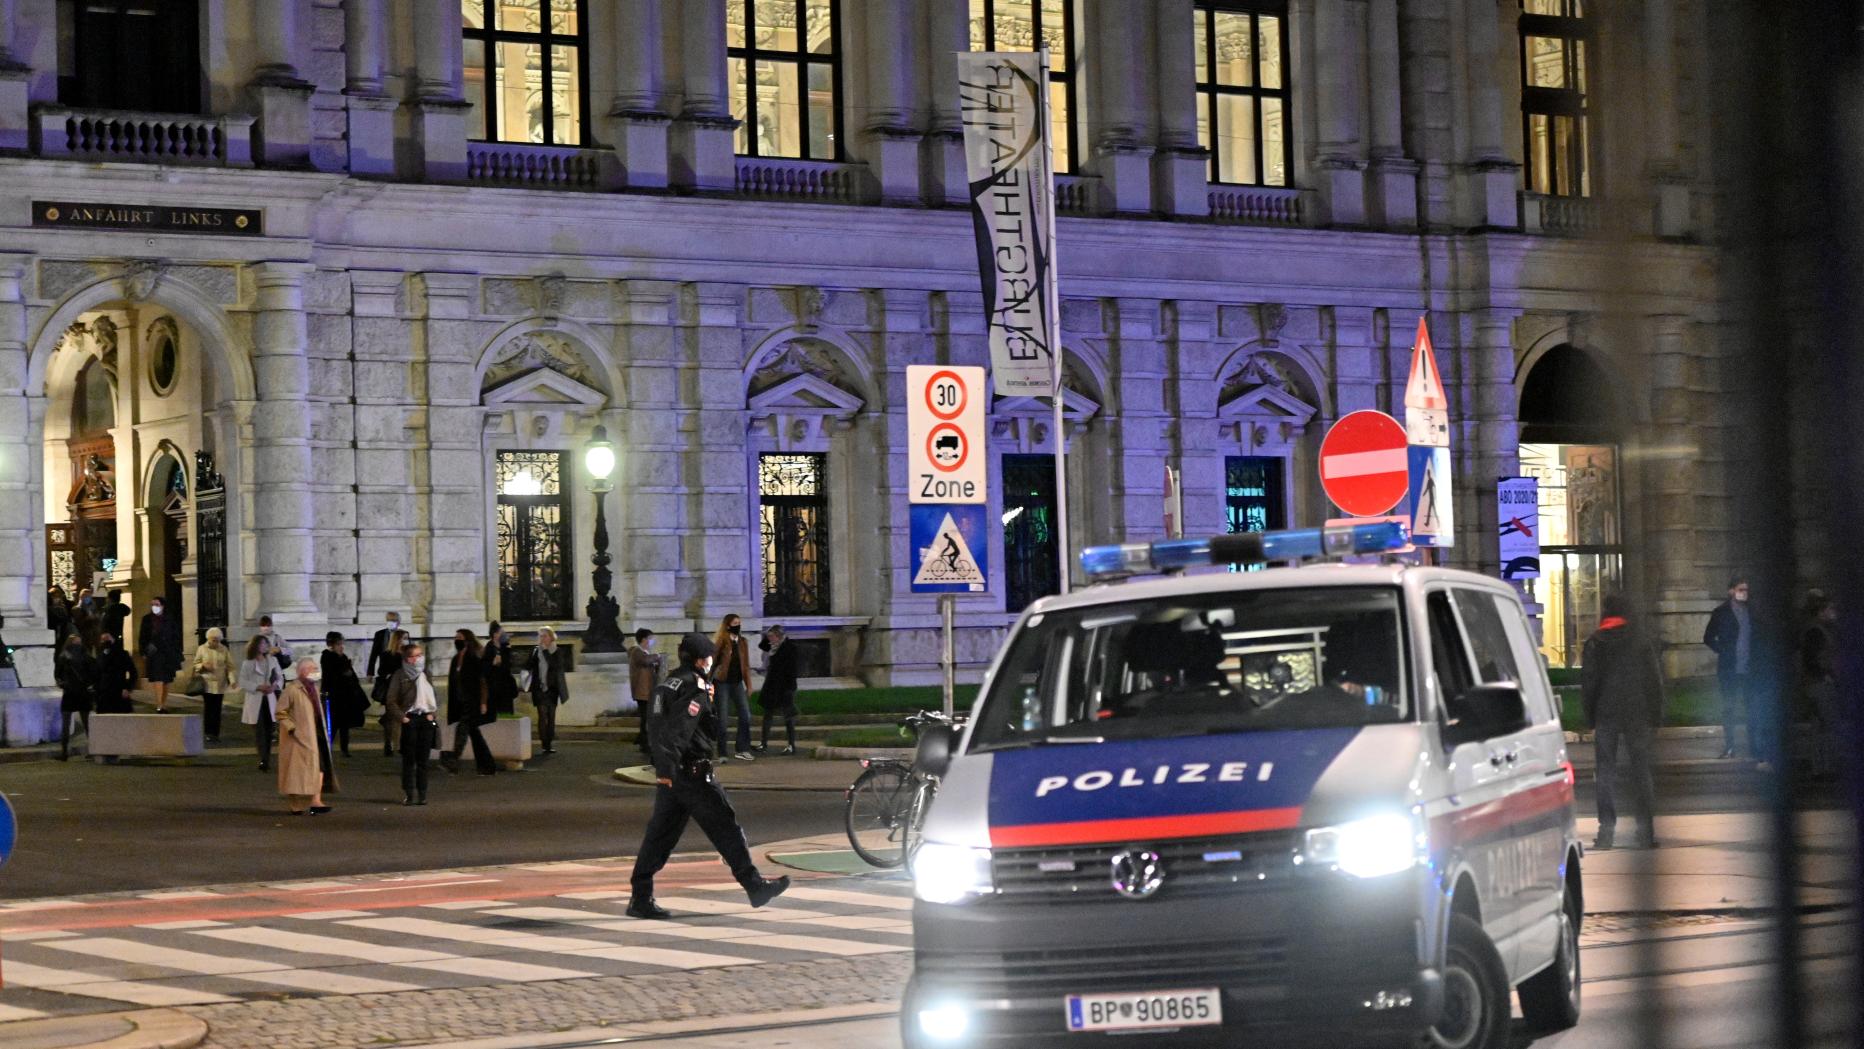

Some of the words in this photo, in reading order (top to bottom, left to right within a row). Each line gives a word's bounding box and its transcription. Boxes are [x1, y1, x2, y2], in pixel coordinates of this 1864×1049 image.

[69, 207, 154, 223] ANFAHRT
[171, 211, 223, 227] LINKS
[937, 384, 956, 406] 30
[920, 473, 975, 498] Zone
[1500, 489, 1513, 505] ABO
[1035, 762, 1274, 797] POLIZEI
[1090, 1001, 1118, 1024] BP
[1136, 996, 1210, 1022] 90865
